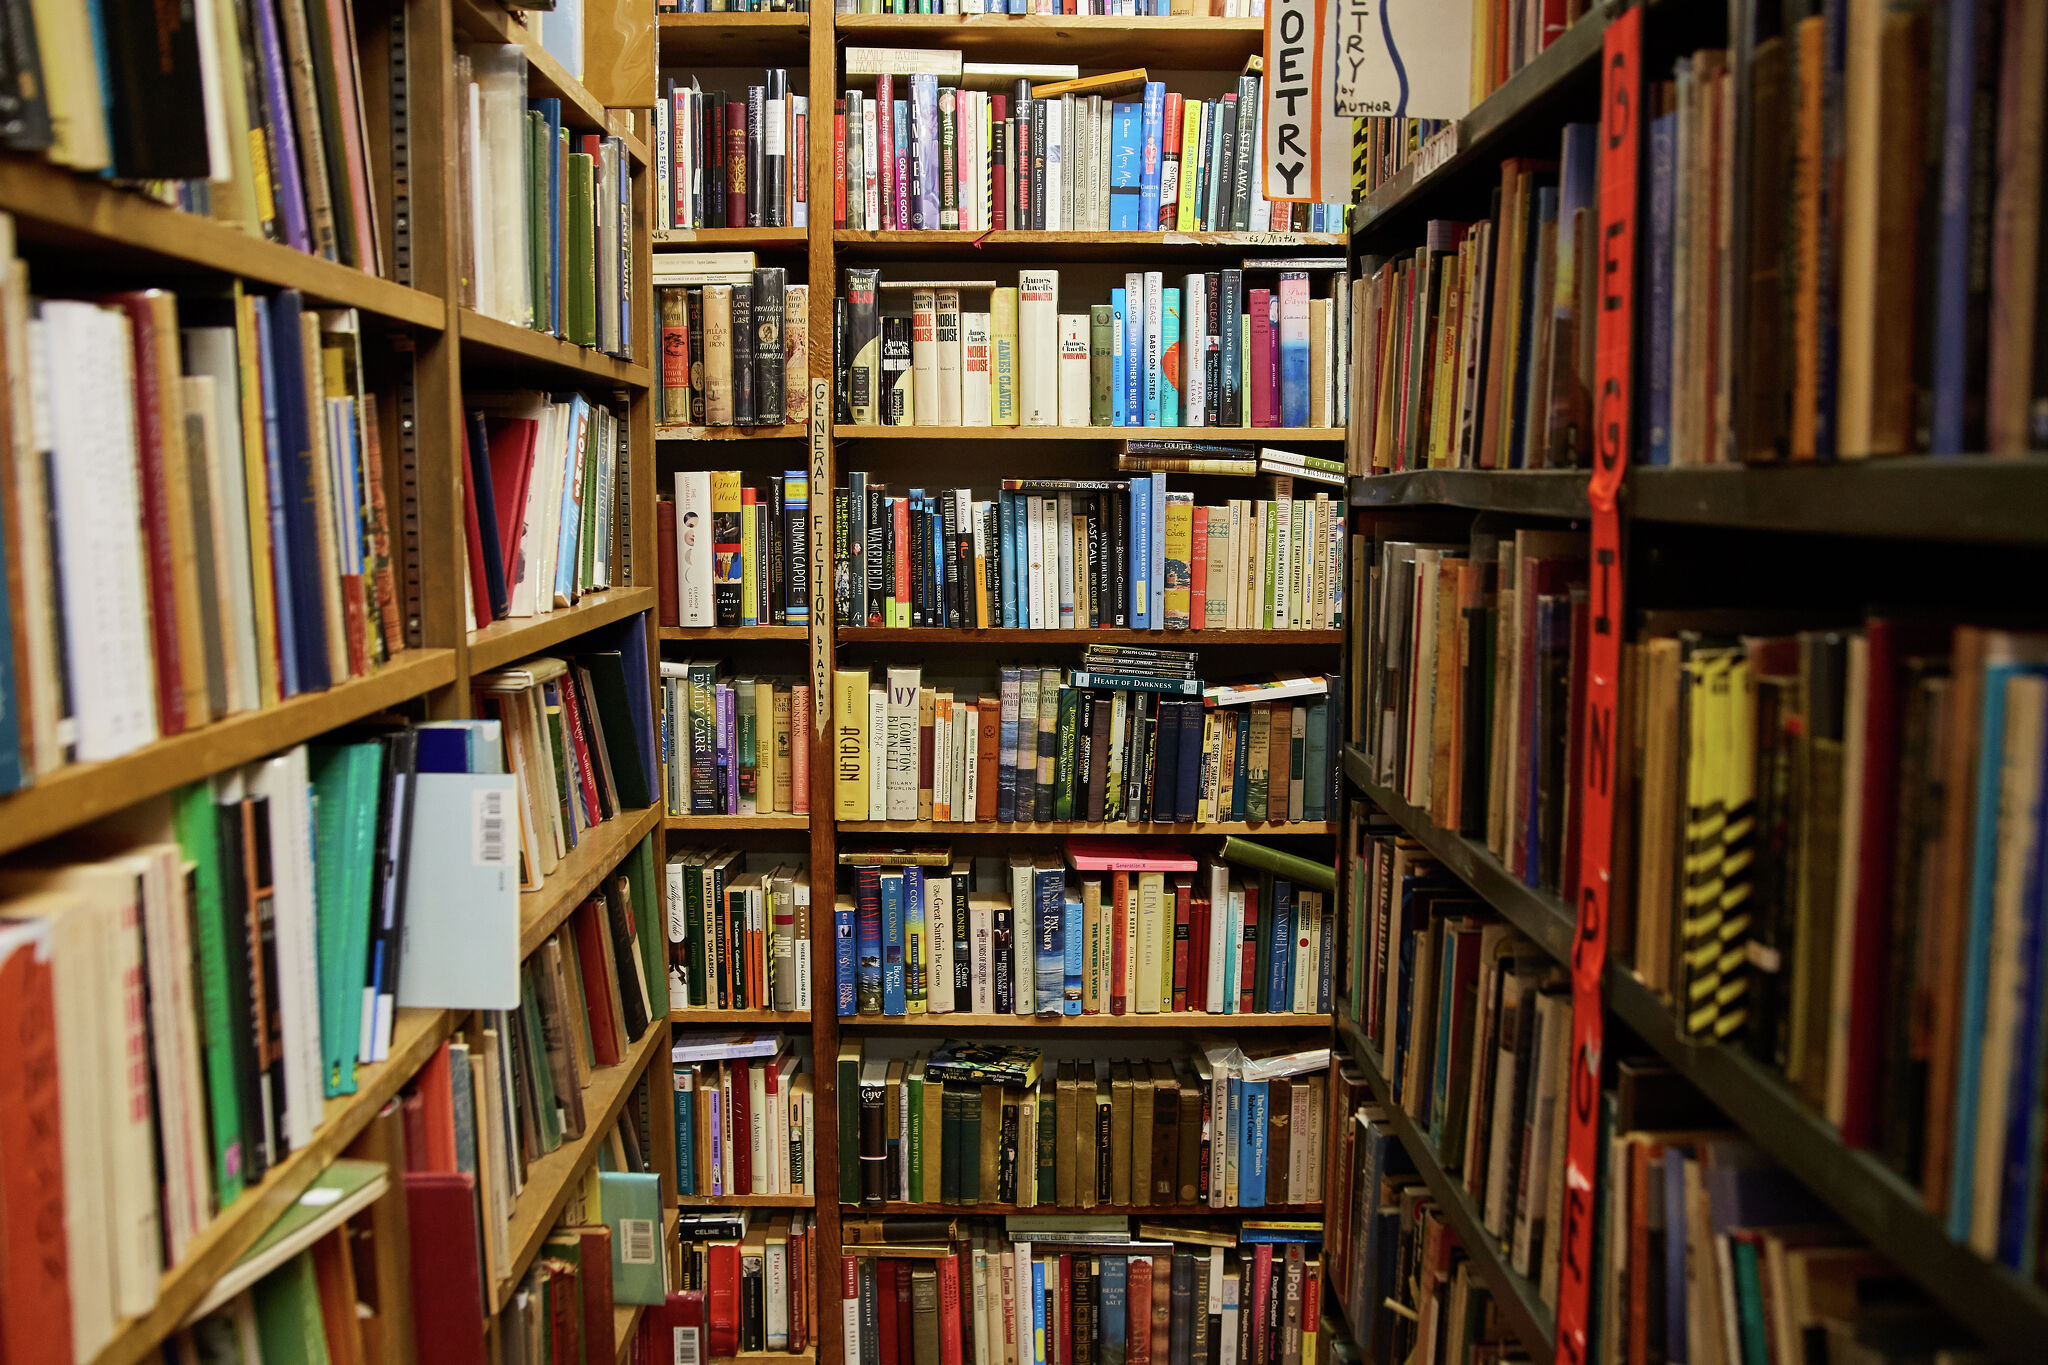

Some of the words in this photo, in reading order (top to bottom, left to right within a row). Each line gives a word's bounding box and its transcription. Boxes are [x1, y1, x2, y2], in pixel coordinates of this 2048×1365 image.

[880, 84, 889, 112] Georgia
[1276, 0, 1308, 194] OETRY
[1341, 87, 1354, 97] by
[1338, 100, 1392, 113] AUTHOR
[1020, 124, 1028, 153] DANIEL
[1188, 112, 1197, 143] CARAMELO
[1223, 132, 1232, 147] LAKE
[944, 150, 953, 170] MARK
[1116, 146, 1134, 168] Merry
[1187, 146, 1196, 168] SANDRA
[1240, 132, 1250, 164] STEAL
[1020, 156, 1028, 176] HALF
[1116, 170, 1132, 188] Men
[1222, 149, 1231, 183] MONSTERS
[883, 172, 891, 206] Childress
[944, 172, 953, 206] CHILDRESS
[1020, 179, 1028, 210] HUMAN
[1185, 170, 1194, 199] CISNEROS
[1237, 168, 1247, 199] AWAY
[848, 275, 874, 284] James
[849, 282, 874, 291] Clavell
[1021, 283, 1053, 292] Clavell's
[1021, 292, 1053, 302] WHIRLWIND
[967, 359, 988, 372] HOUSE
[968, 346, 988, 359] NOBLE
[998, 340, 1010, 374] JAMES
[1000, 376, 1012, 418] CLAVELL
[813, 382, 825, 495] GENERAL
[871, 493, 879, 524] Codrescu
[1294, 503, 1303, 520] LAURIE
[792, 517, 804, 554] TRUMAN
[1294, 521, 1302, 541] COLWIN
[813, 516, 825, 626] FICTION
[868, 527, 882, 590] WAKEFIELD
[793, 556, 805, 592] CAPOTE
[694, 674, 705, 715] EMILY
[816, 659, 825, 716] Author
[1094, 677, 1118, 685] HEART
[1134, 680, 1172, 689] DARKNESS
[802, 714, 808, 722] on
[1068, 707, 1076, 732] JOSEPH
[694, 718, 705, 753] CARR
[888, 716, 898, 771] BURNETT
[840, 726, 860, 781] ACALAN
[1210, 766, 1218, 786] SHARER
[860, 870, 879, 890] PAT
[933, 898, 943, 920] Great
[1042, 886, 1051, 912] TIDES
[1143, 884, 1157, 915] ELENA
[861, 897, 880, 940] CONROY
[957, 911, 965, 939] CONROY
[934, 923, 944, 951] Santini
[1043, 916, 1052, 951] CONROY
[934, 965, 942, 987] Conroy
[1199, 1274, 1208, 1297] THE
[1271, 1276, 1279, 1299] Douglas
[1287, 1264, 1300, 1300] JPod
[1196, 1300, 1207, 1346] TONTINE
[1271, 1300, 1279, 1327] Coupland
